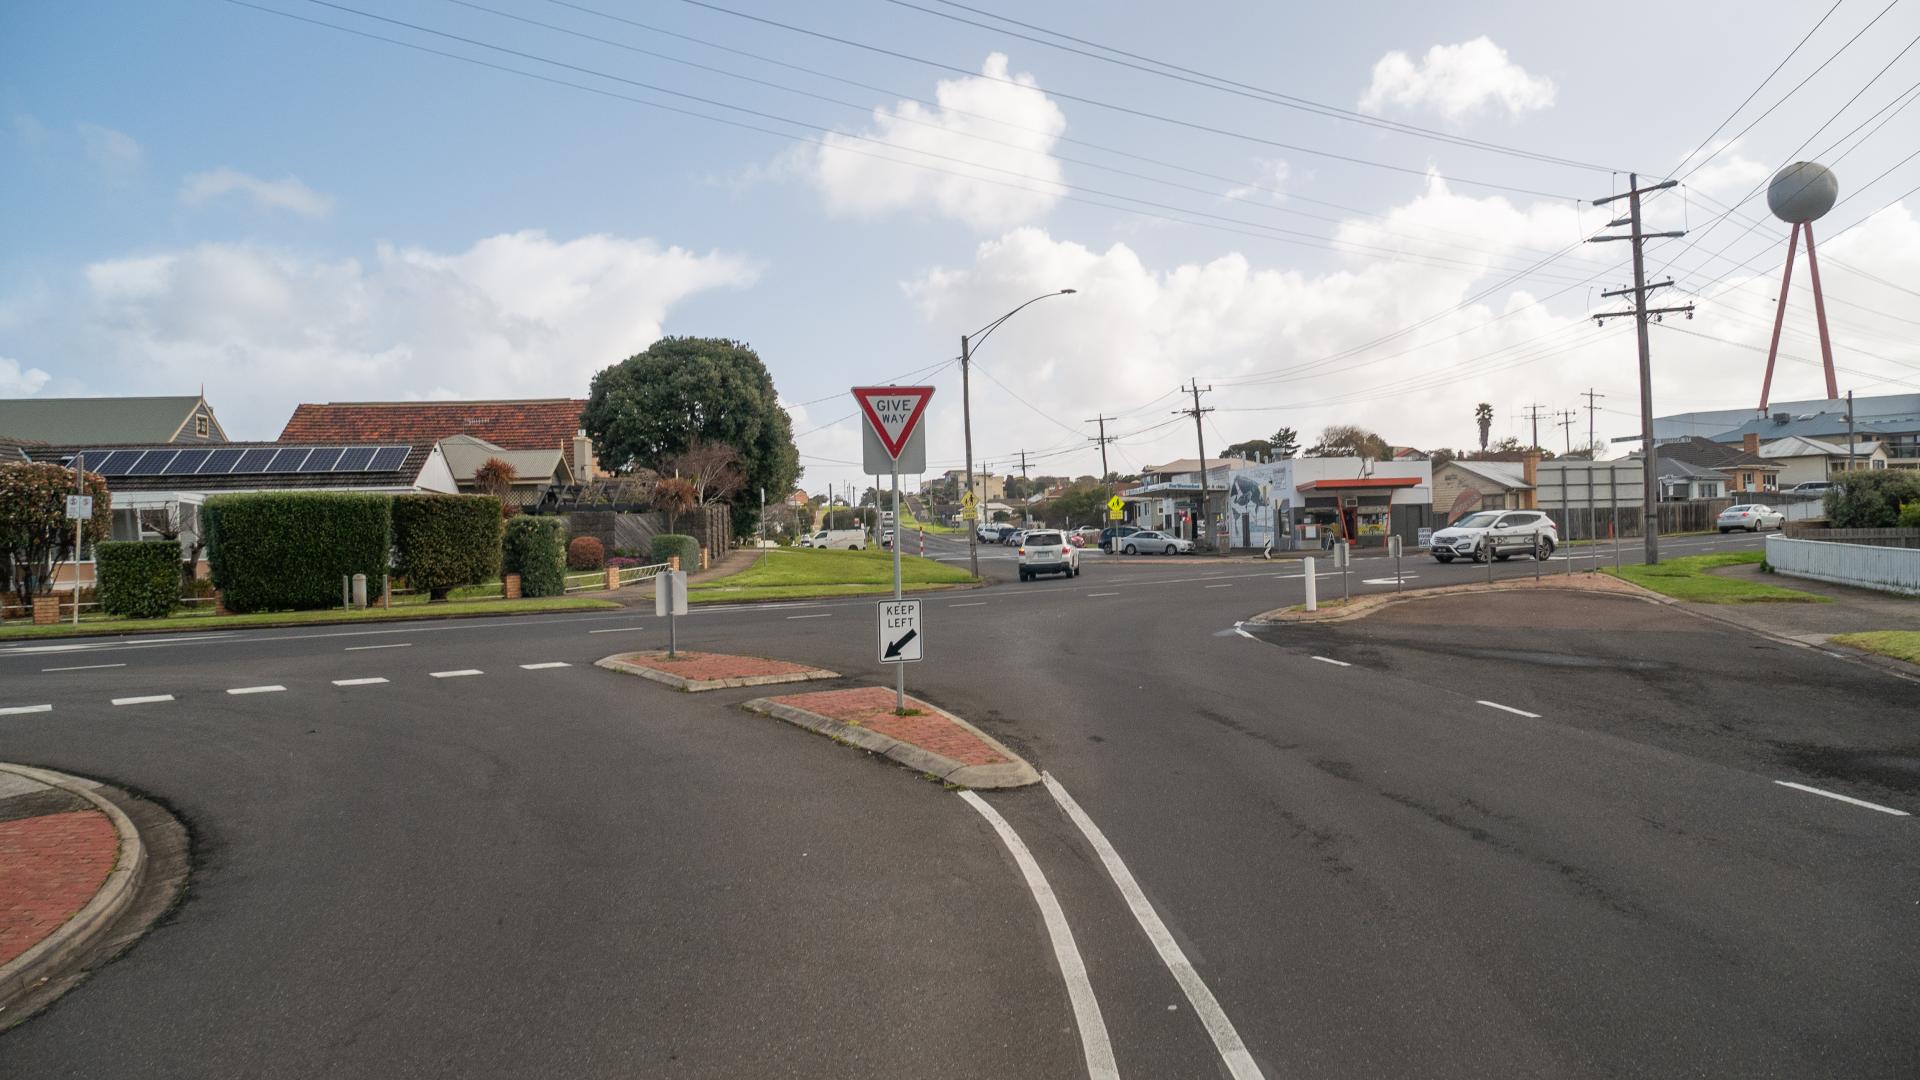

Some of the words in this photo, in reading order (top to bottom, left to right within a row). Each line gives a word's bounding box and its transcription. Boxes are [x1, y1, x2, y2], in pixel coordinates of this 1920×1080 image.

[876, 399, 911, 411] GIVE
[882, 414, 906, 423] WAY
[886, 605, 914, 616] KEEP
[888, 617, 914, 628] LEFT
